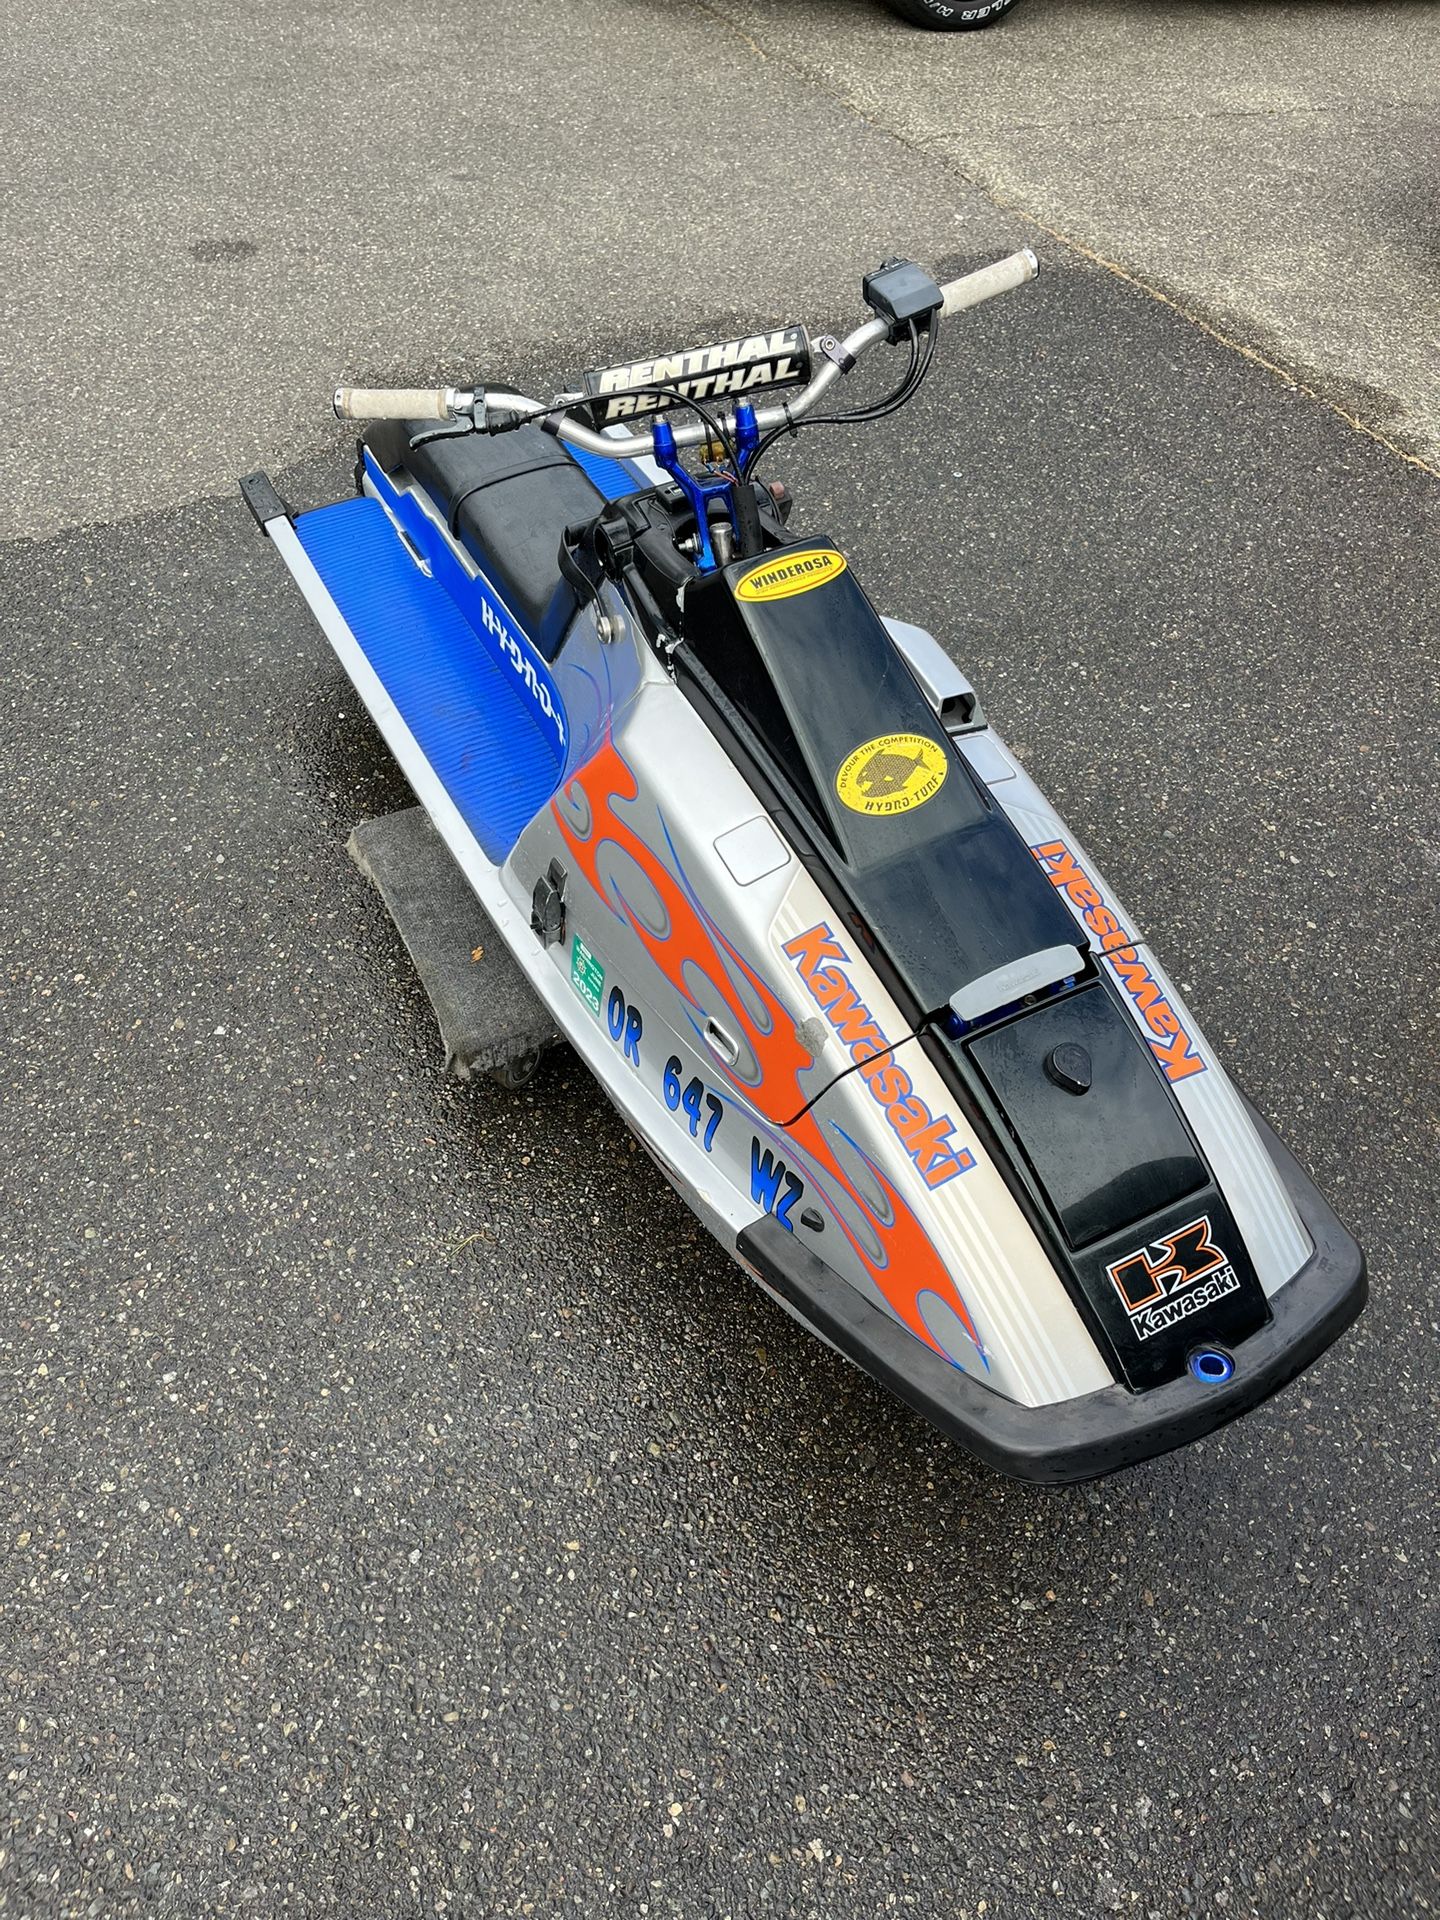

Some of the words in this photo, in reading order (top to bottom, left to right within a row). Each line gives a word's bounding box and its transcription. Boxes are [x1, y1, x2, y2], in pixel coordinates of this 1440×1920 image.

[961, 0, 1011, 20] LER
[599, 331, 797, 393] RENTHAL
[749, 555, 833, 589] WINDEROSA
[840, 756, 859, 788] DEVOUR
[860, 744, 875, 756] THE
[878, 736, 938, 753] COMPETITION
[864, 776, 939, 811] HYDRO-TURF
[1030, 839, 1208, 1083] Kawasaki
[572, 970, 599, 1012] 2023
[781, 921, 978, 1191] Kawasaki
[608, 985, 642, 1067] OR
[663, 1055, 723, 1153] 647
[751, 1135, 804, 1233] WZ
[1130, 1265, 1241, 1341] Kawasaki
